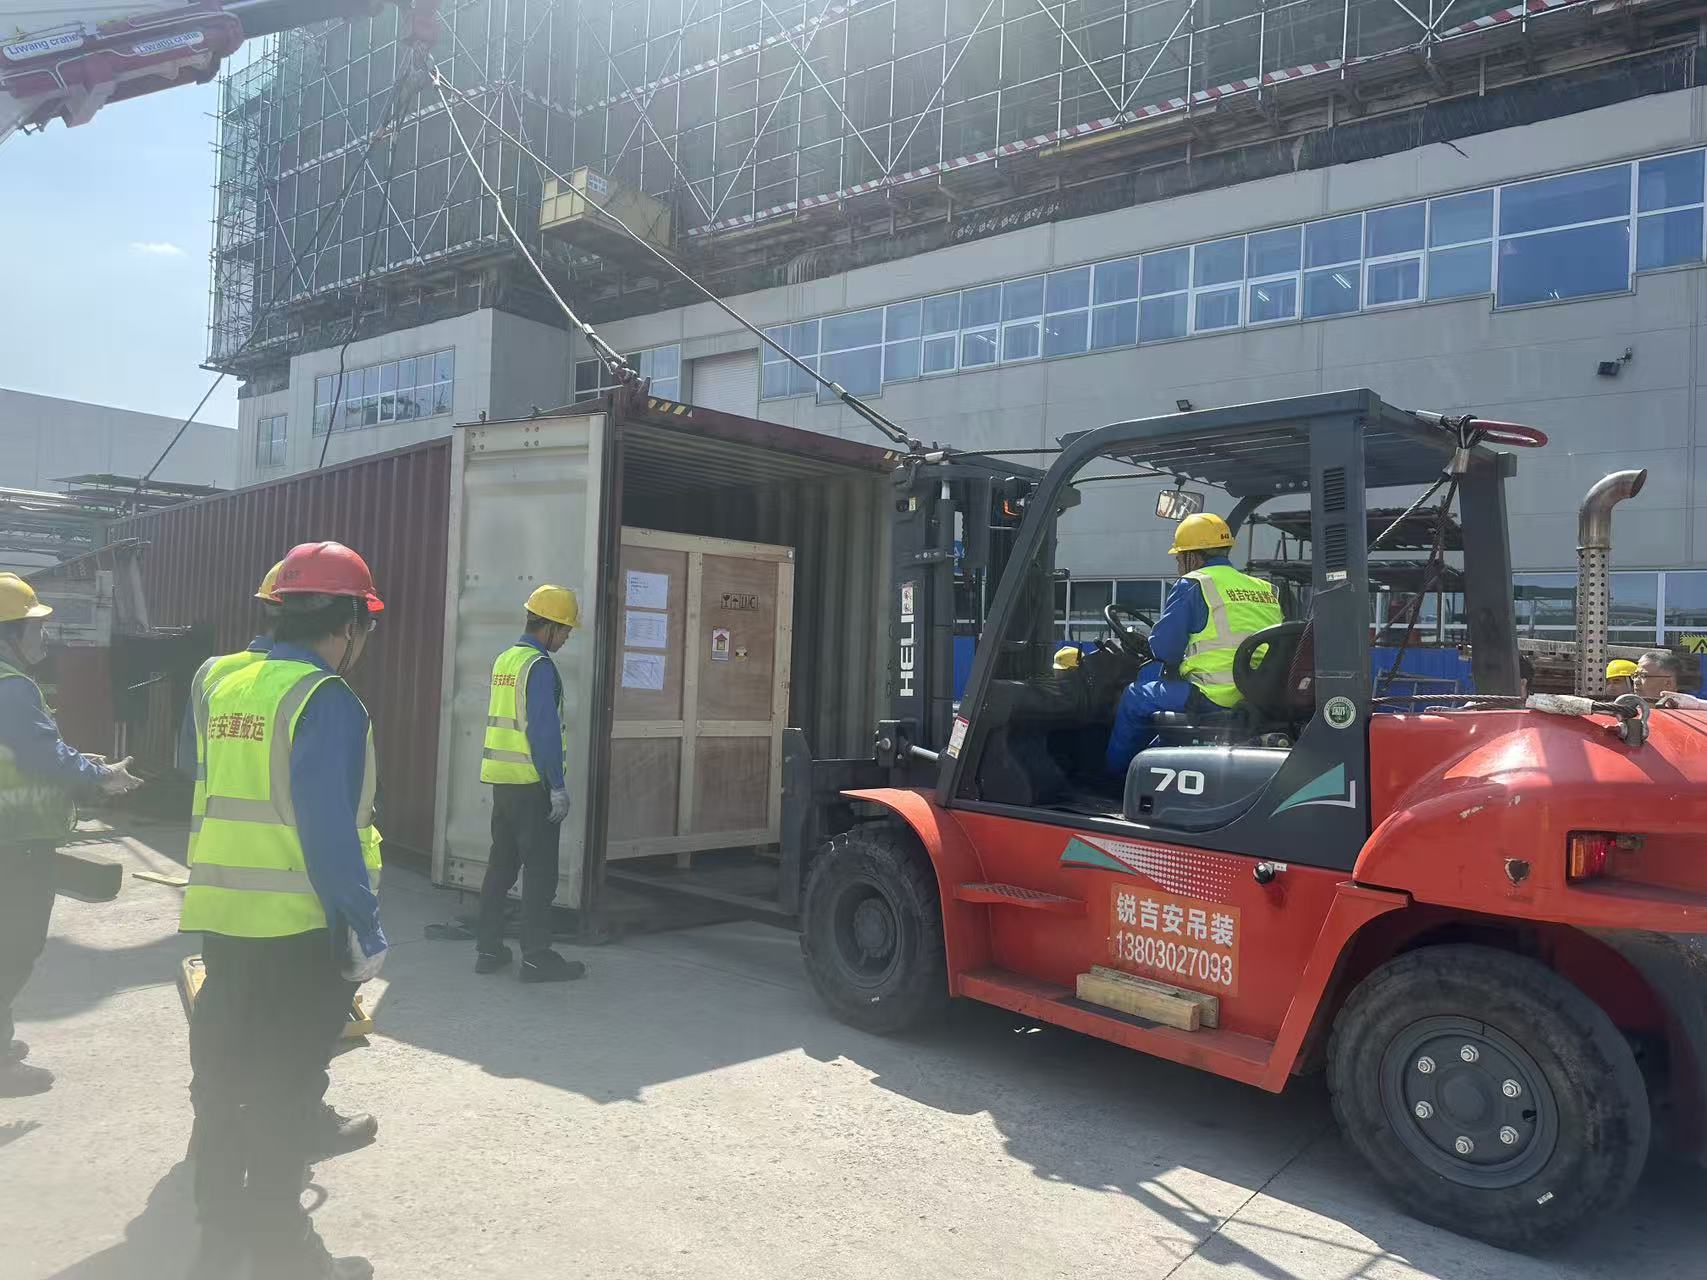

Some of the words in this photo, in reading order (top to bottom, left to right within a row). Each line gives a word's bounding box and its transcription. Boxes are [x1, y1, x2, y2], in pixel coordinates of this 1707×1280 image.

[900, 615, 914, 696] HELI
[1150, 767, 1205, 795] 70
[1116, 892, 1234, 948] 锐吉安吊装
[1115, 929, 1233, 986] 13803027093
